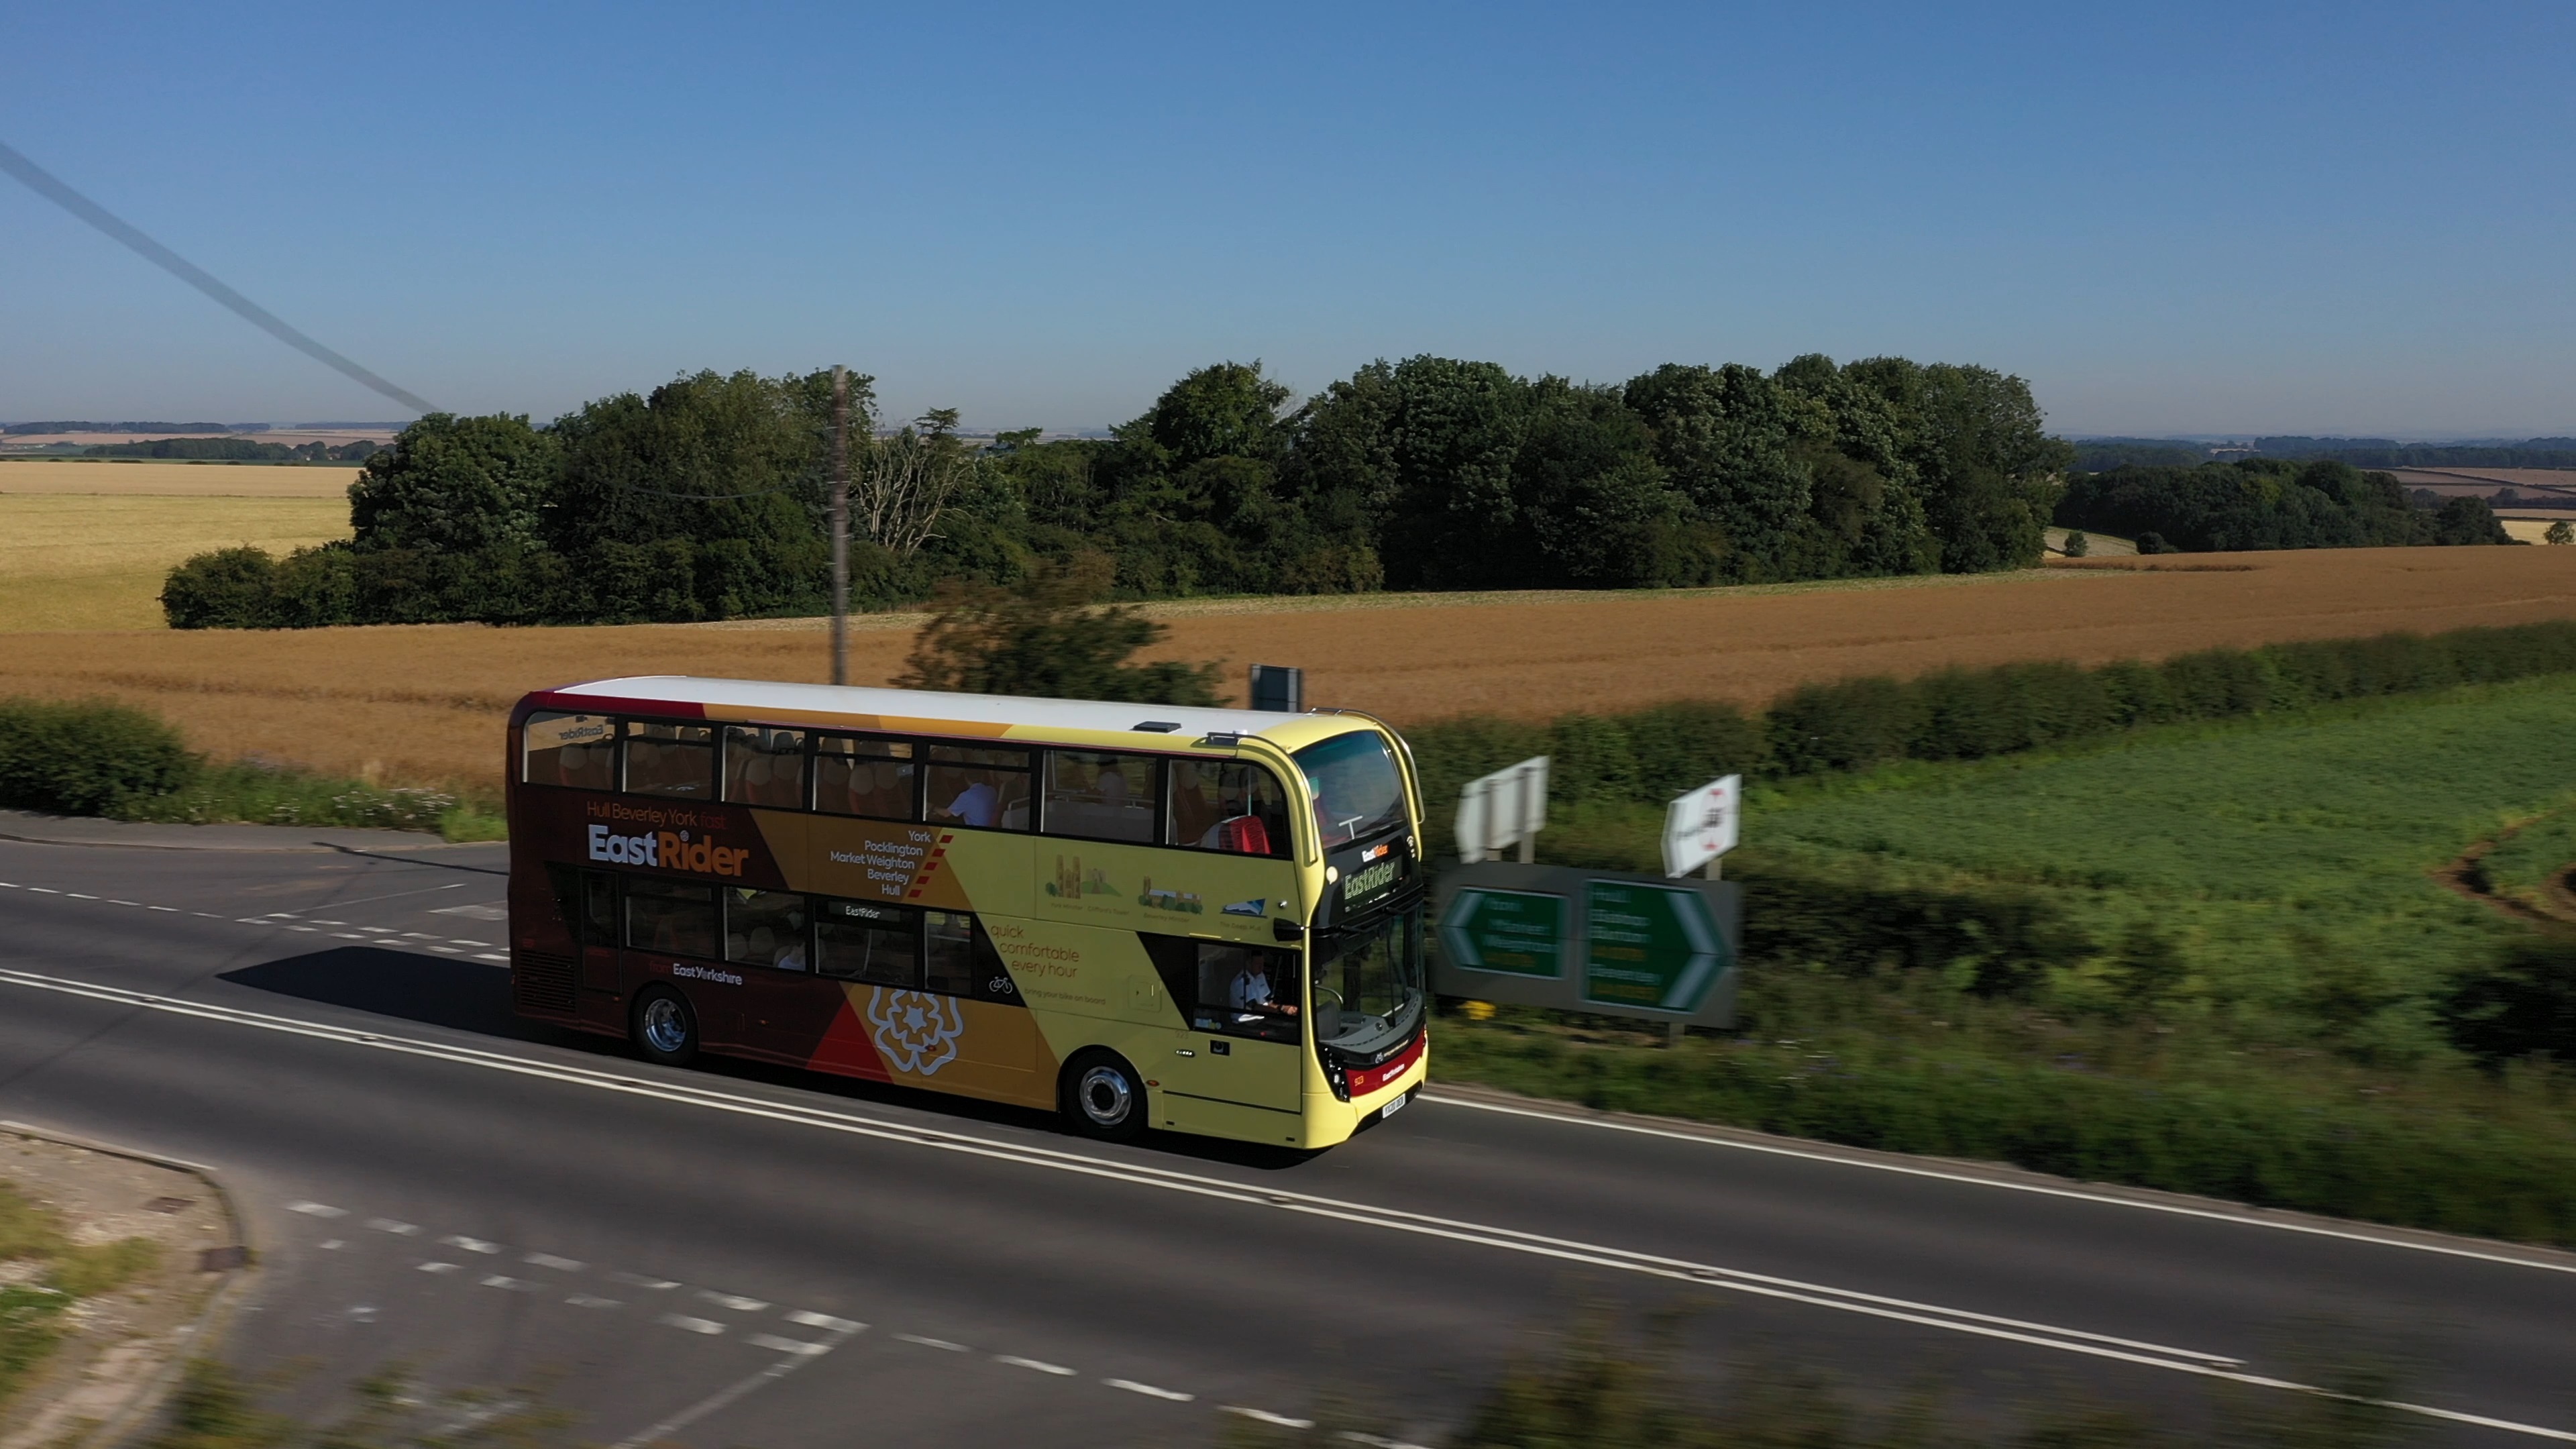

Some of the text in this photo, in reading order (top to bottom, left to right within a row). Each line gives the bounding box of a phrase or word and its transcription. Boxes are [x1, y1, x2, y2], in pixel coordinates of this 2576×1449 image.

[586, 800, 727, 830] Hull Beverley York fast
[908, 830, 931, 843] York
[588, 824, 749, 877] EastRider
[865, 840, 923, 857] Pocklington
[830, 850, 915, 869] Market Weighton
[867, 868, 910, 885] Beverley
[881, 883, 900, 896] Hull
[991, 924, 1024, 938] quick
[1000, 942, 1079, 962] comfortable
[649, 961, 672, 973] from
[1012, 959, 1078, 977] every hour
[1024, 988, 1042, 998] bring
[1085, 996, 1106, 1005] board
